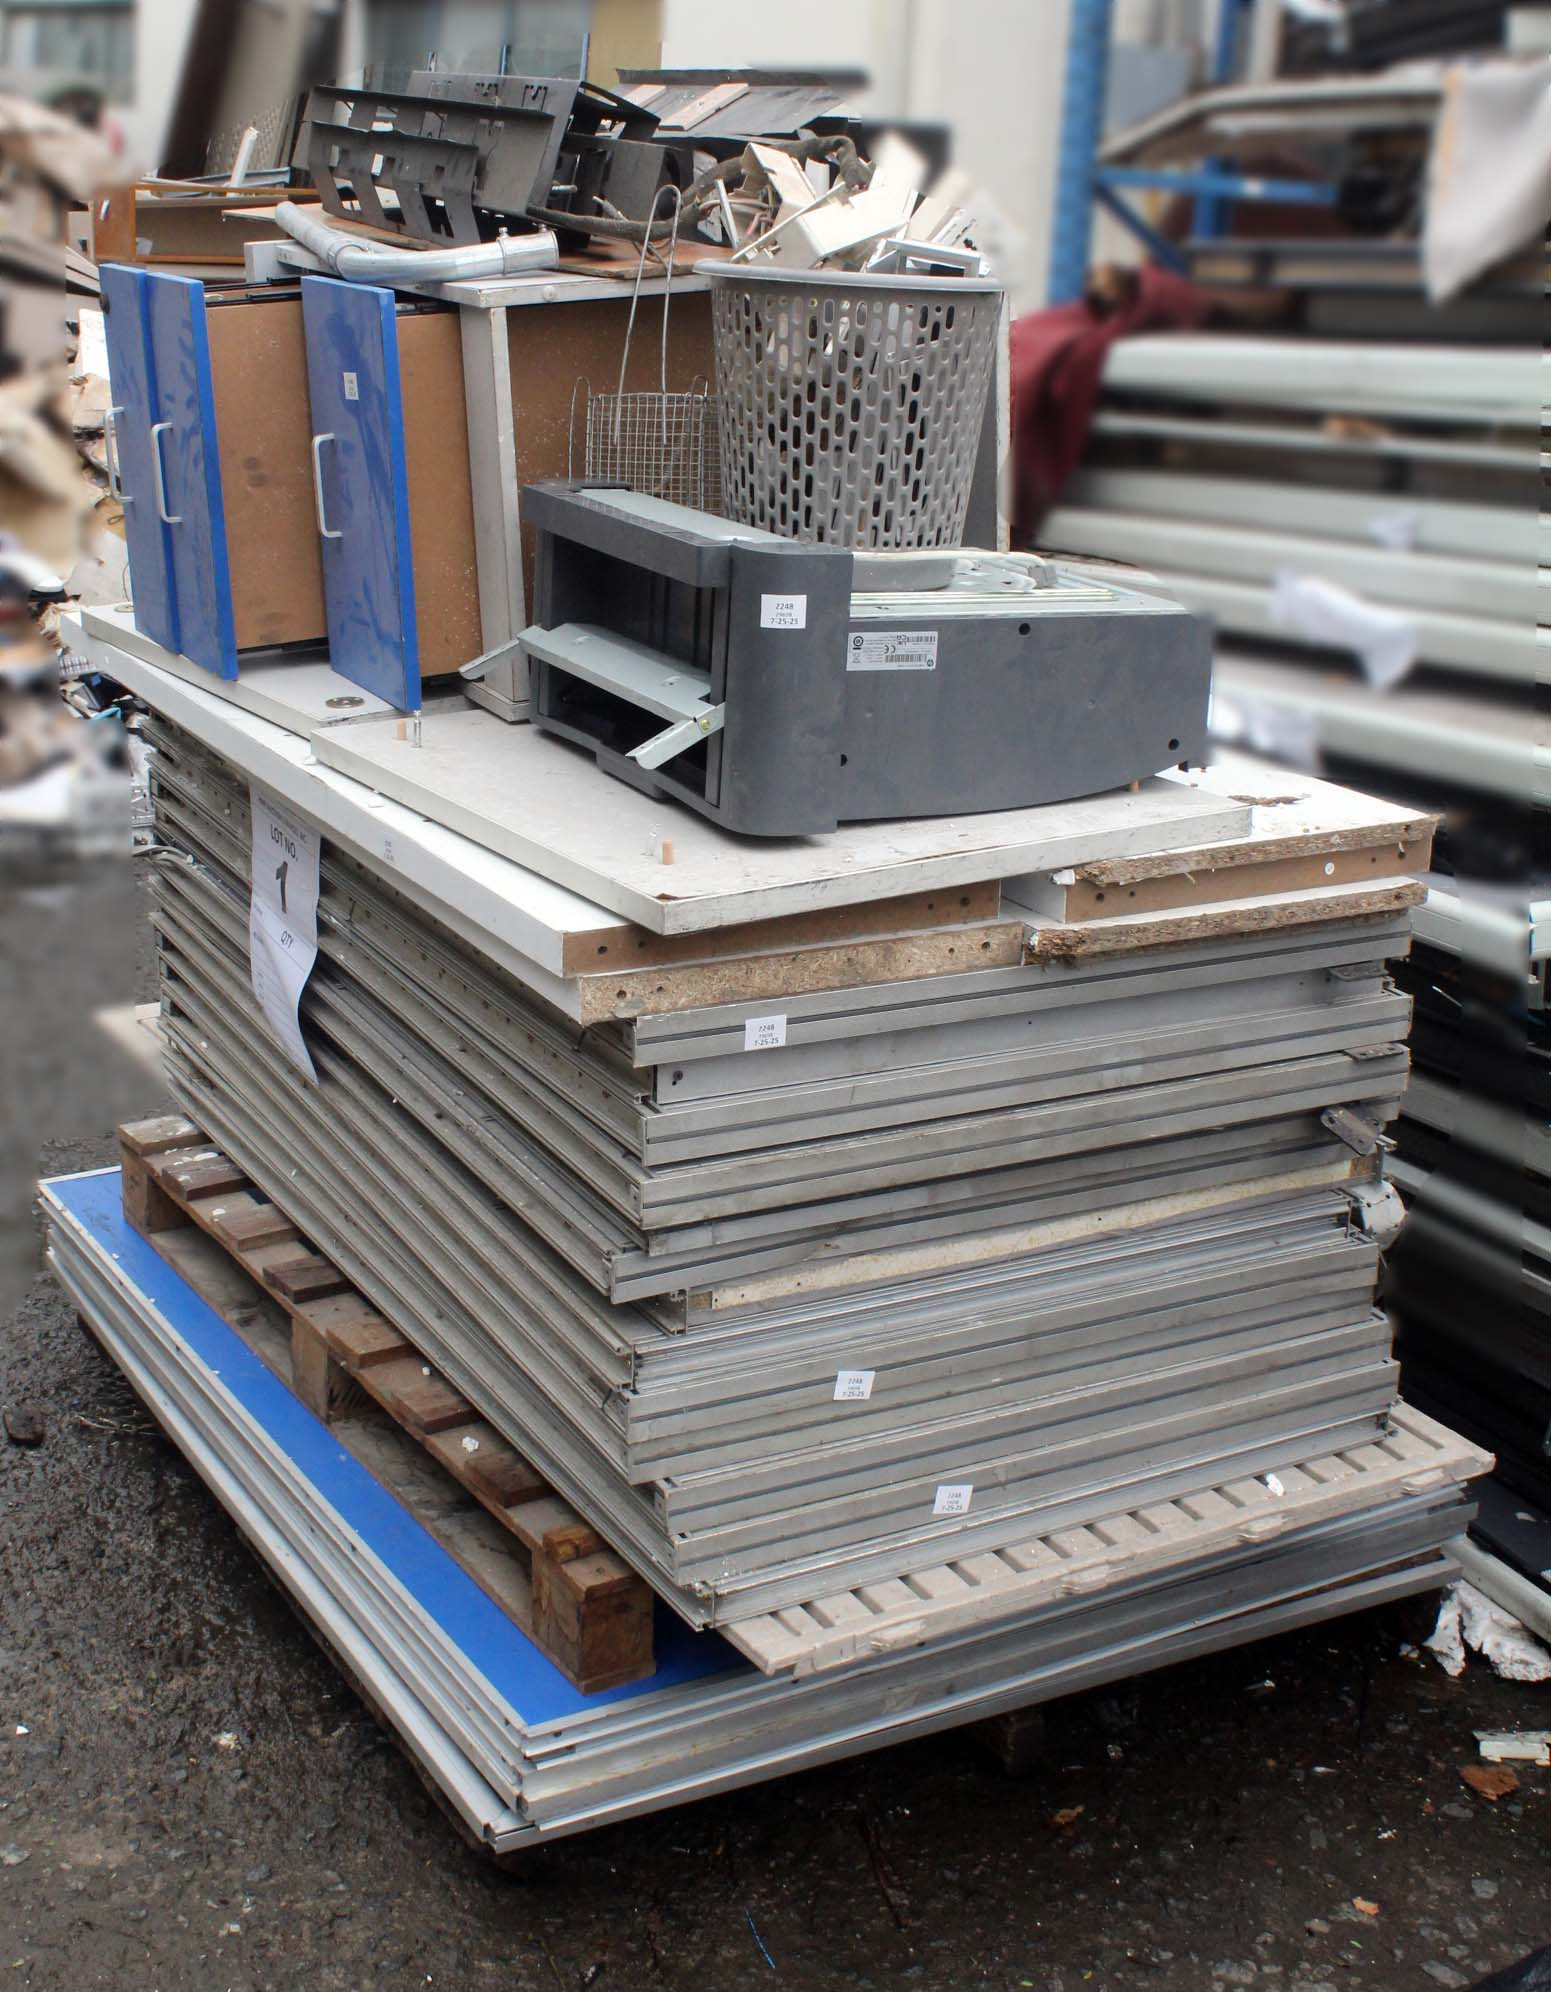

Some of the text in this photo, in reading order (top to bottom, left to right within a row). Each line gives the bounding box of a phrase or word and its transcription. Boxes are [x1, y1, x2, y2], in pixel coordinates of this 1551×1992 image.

[270, 823, 283, 848] LOT
[275, 861, 288, 914] 1
[280, 930, 295, 949] QTY
